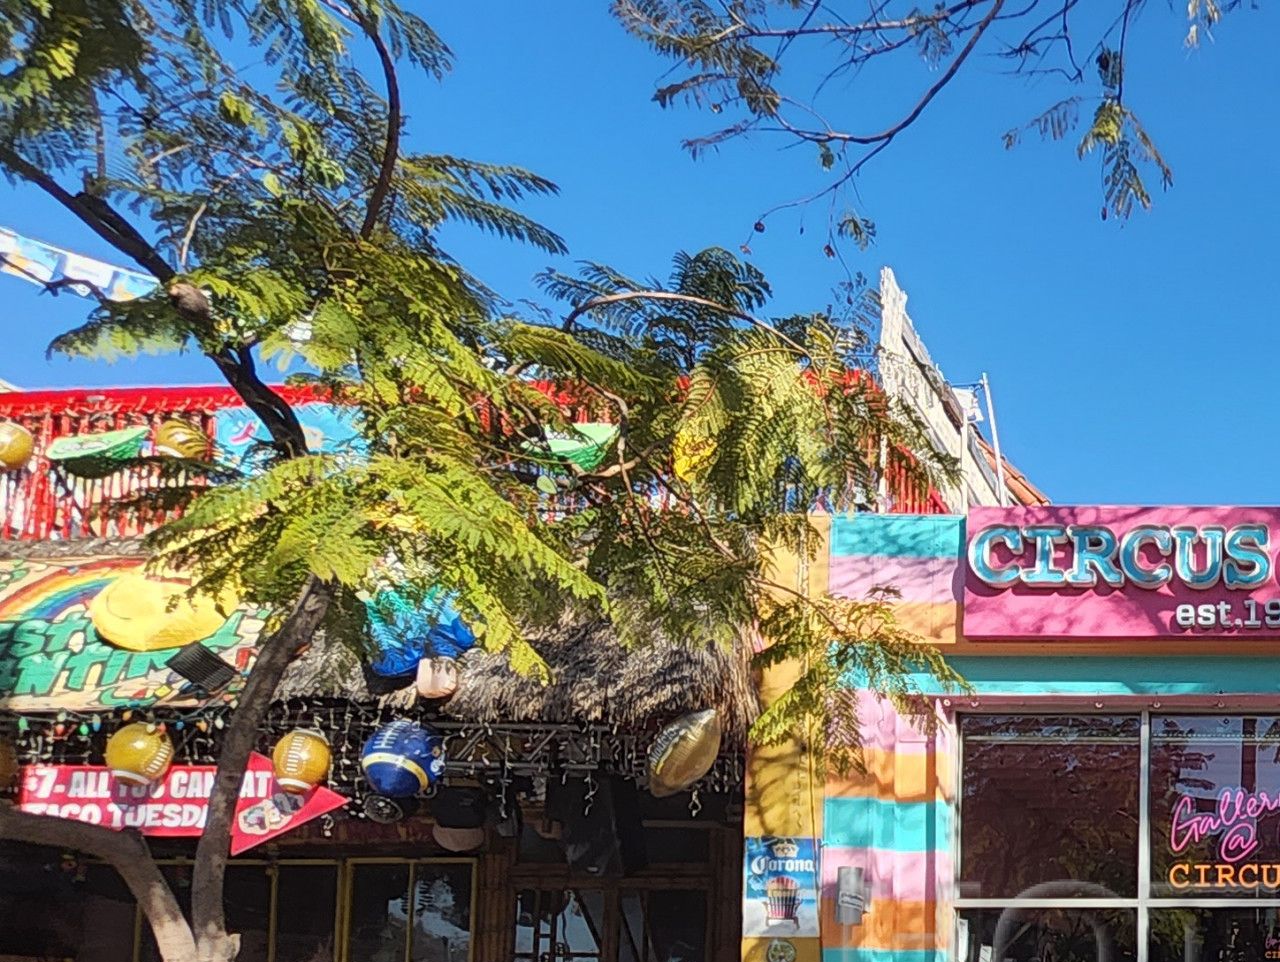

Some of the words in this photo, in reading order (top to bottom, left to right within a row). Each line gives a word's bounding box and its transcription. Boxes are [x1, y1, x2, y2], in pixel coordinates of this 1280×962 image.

[967, 524, 1271, 590] CIRCUS
[67, 771, 111, 798] ALL
[239, 769, 272, 798] AT
[1221, 823, 1258, 862] @
[751, 856, 815, 875] Corona
